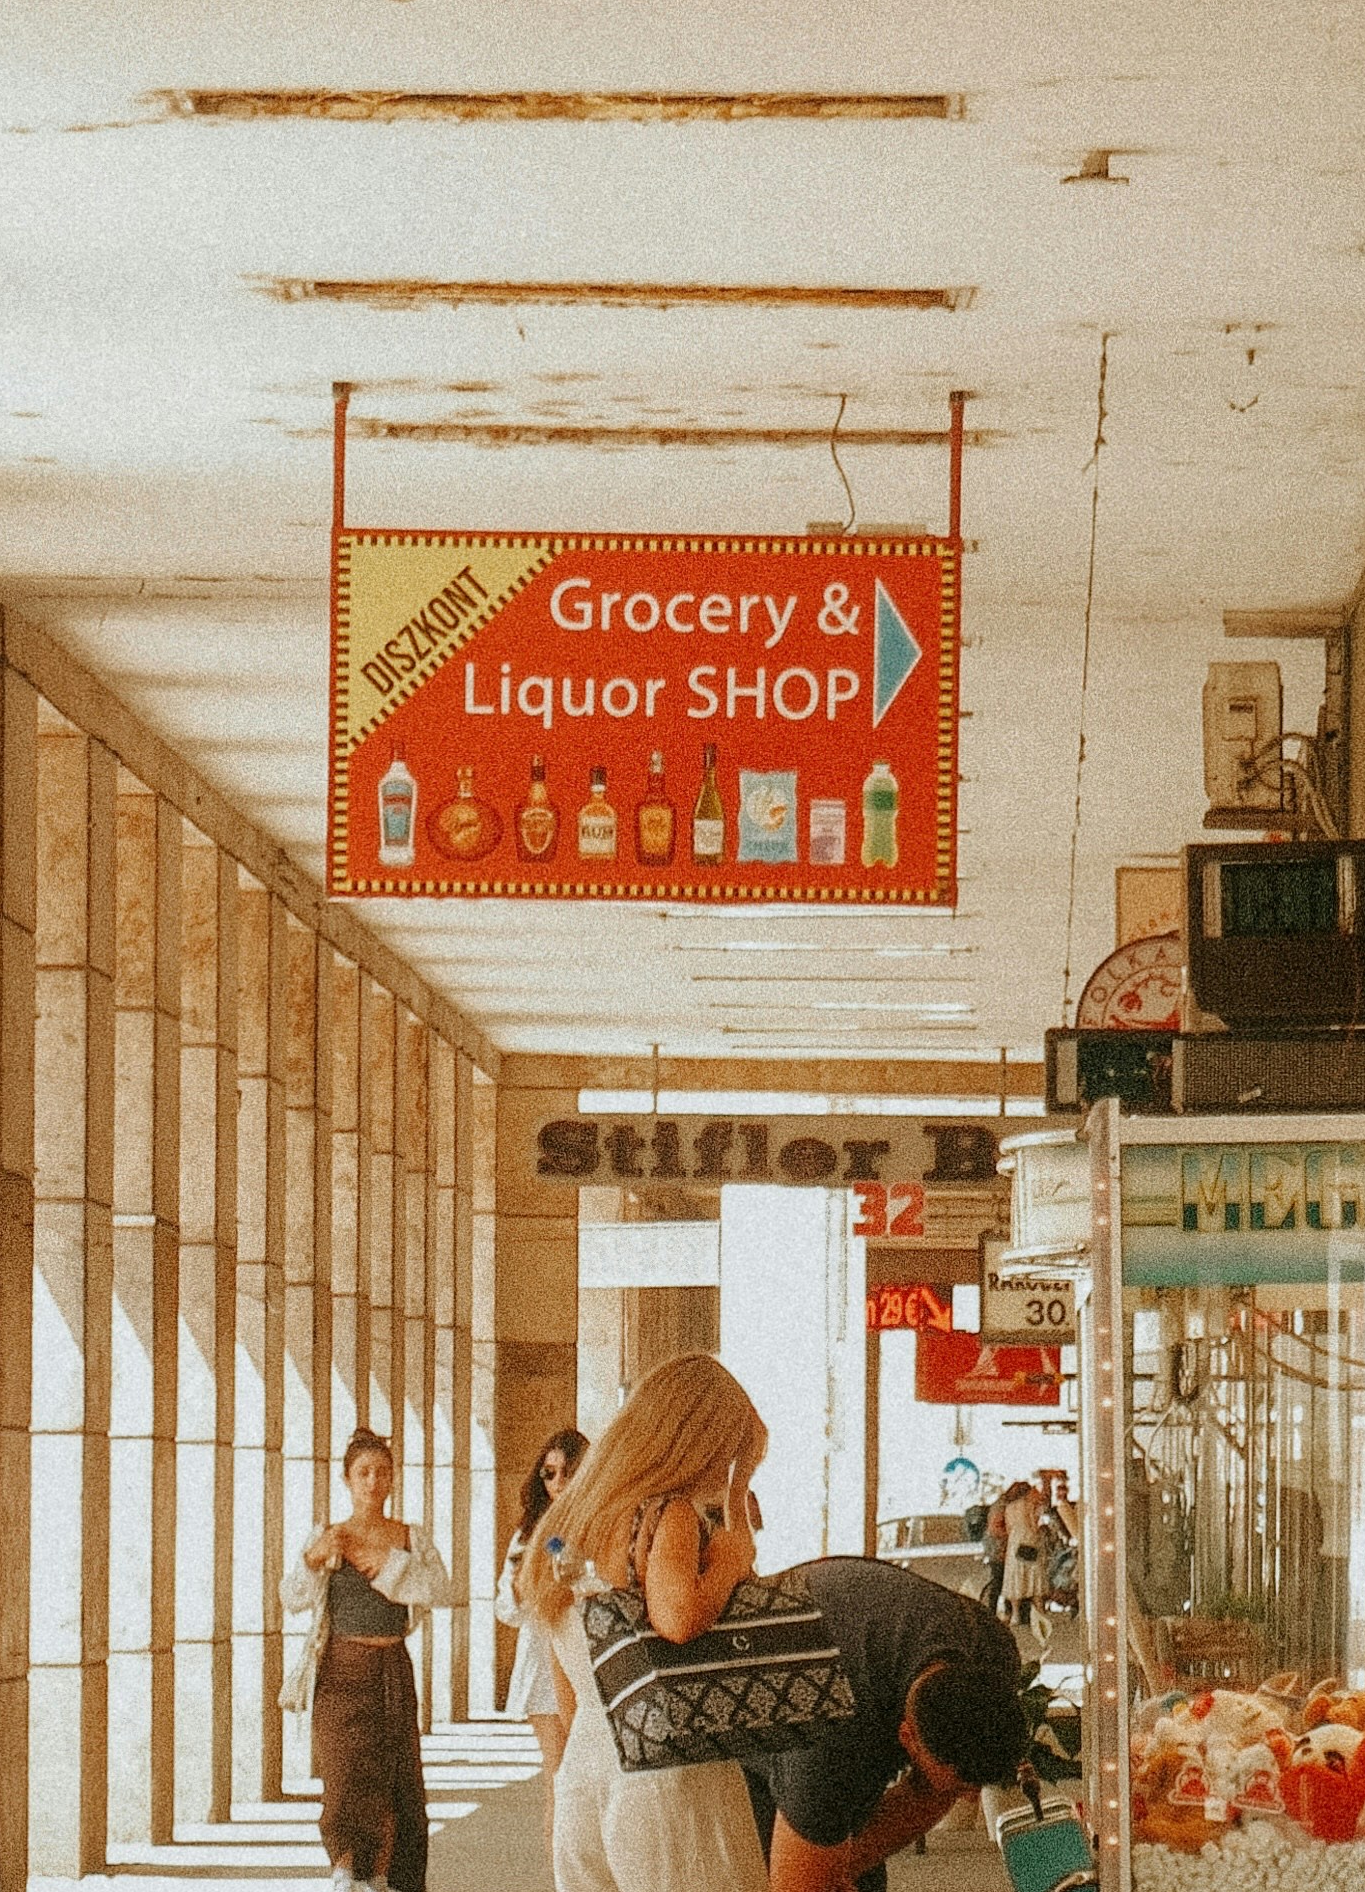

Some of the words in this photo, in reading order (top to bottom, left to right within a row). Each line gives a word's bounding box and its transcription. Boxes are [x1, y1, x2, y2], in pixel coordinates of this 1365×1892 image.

[362, 565, 492, 696] DISZKONT
[549, 577, 797, 648] Grocery
[816, 583, 860, 636] &
[464, 661, 662, 730] Liquor
[687, 666, 860, 721] SHOP
[853, 1181, 925, 1237] 32
